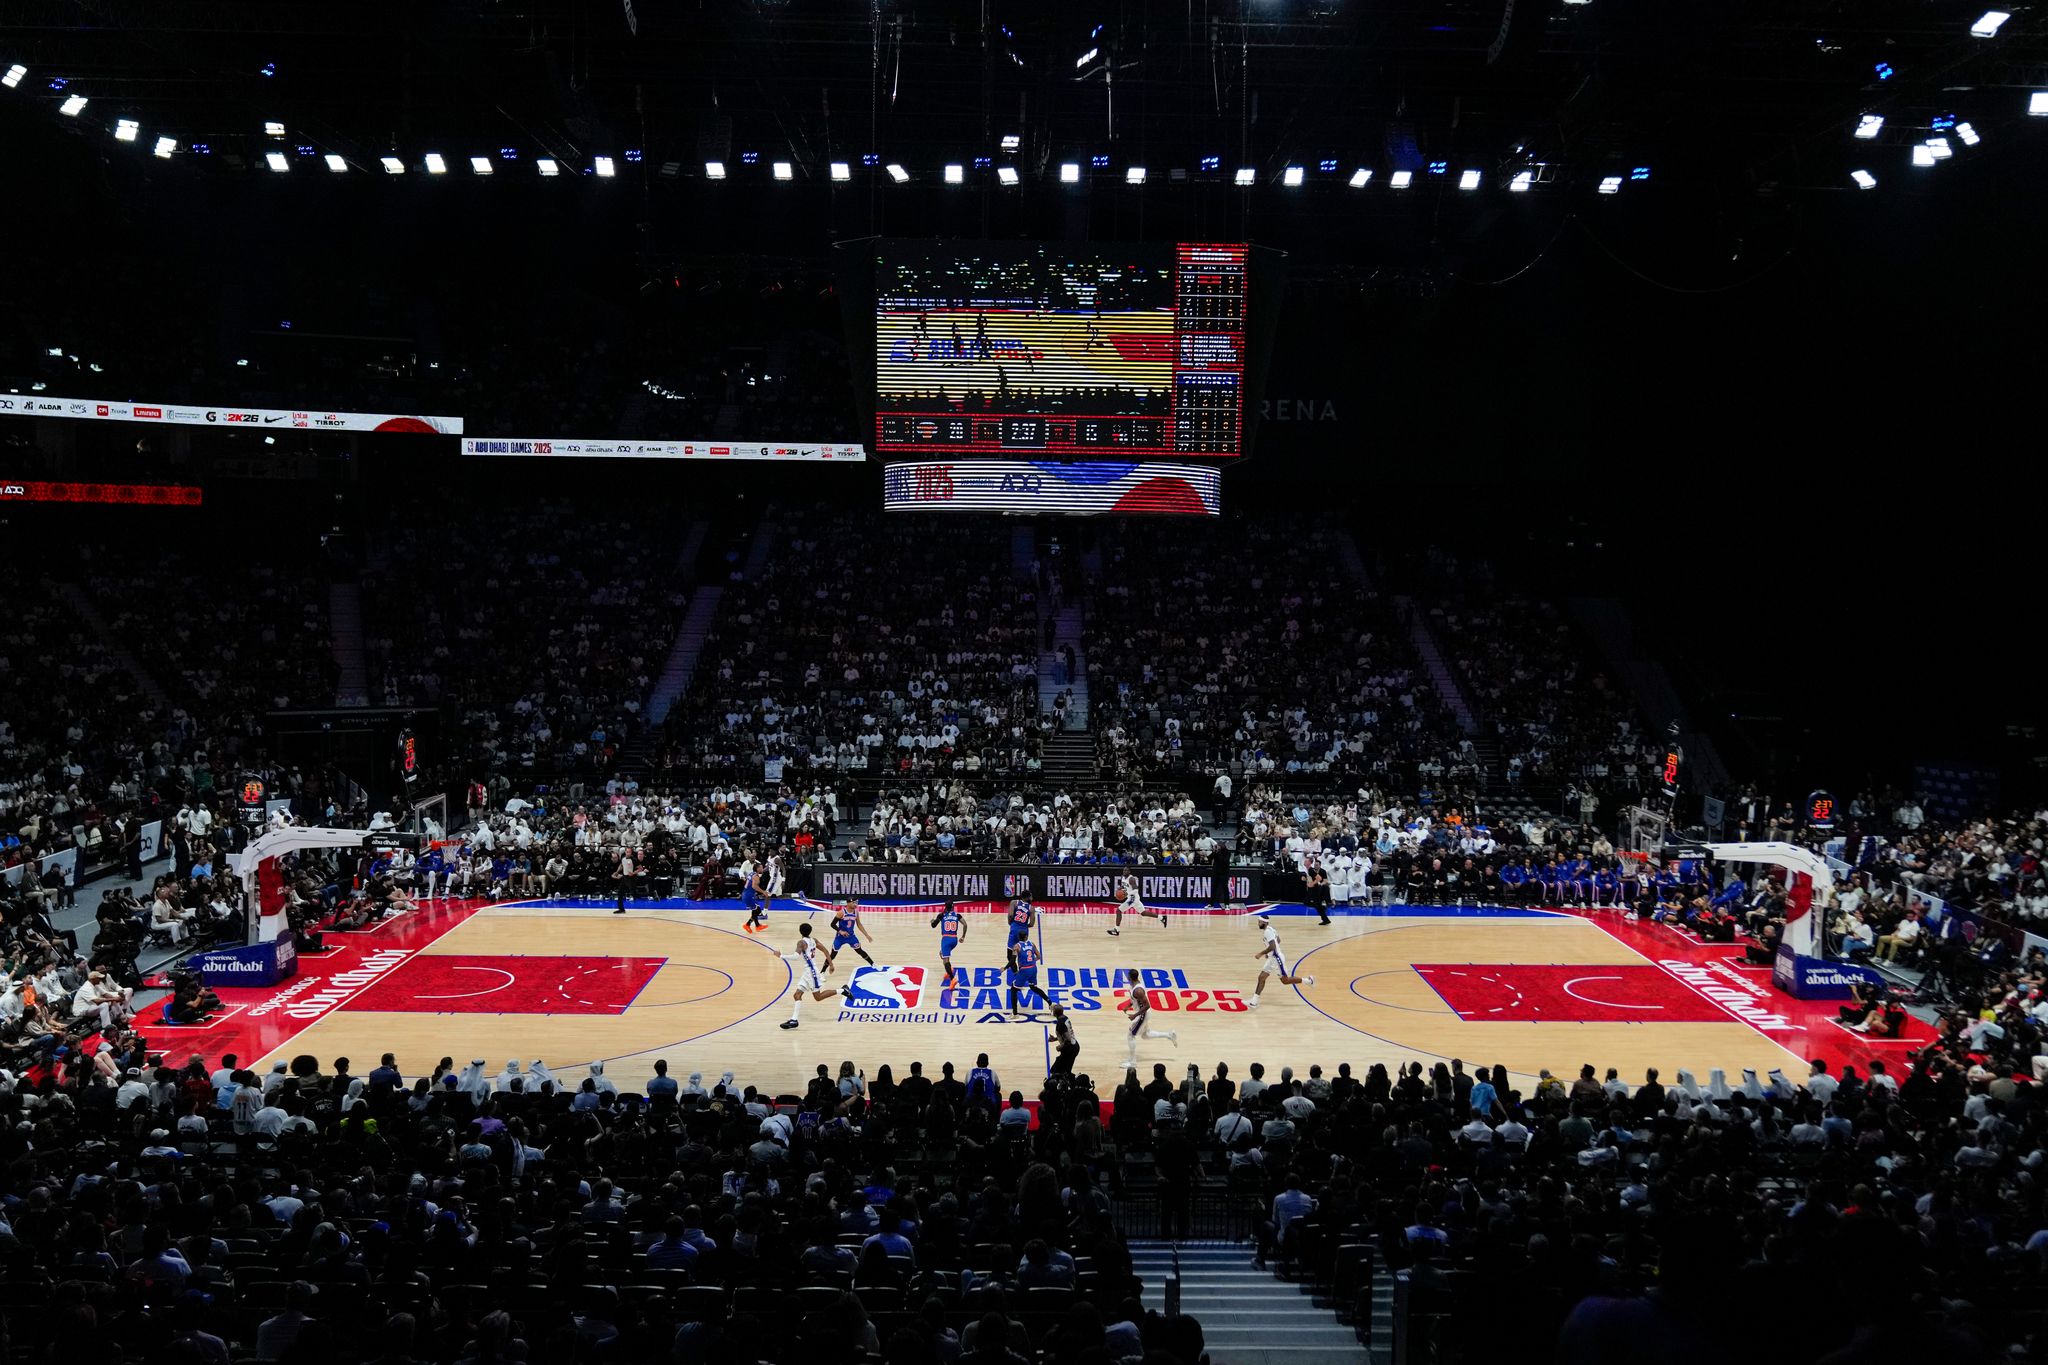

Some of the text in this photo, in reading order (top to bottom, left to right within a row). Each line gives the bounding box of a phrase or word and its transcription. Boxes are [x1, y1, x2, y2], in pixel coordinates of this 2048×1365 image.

[1260, 399, 1338, 421] RENA
[475, 442, 552, 454] ABU DHABI GAMES 2025
[1813, 807, 1830, 819] 22
[823, 873, 989, 897] REWARDS FOR EVERY FAN
[1047, 875, 1111, 897] REWARDS
[1142, 876, 1184, 898] EVERY
[1187, 877, 1212, 898] FAN
[1236, 877, 1250, 898] iD
[1014, 910, 1028, 924] 23
[202, 961, 264, 972] abu dhabi
[283, 988, 356, 1019] abu
[329, 948, 415, 987] dhabi
[1047, 968, 1190, 988] DHABI
[1704, 960, 1772, 997] experience
[1806, 974, 1829, 985] abu
[247, 976, 322, 1016] experience
[853, 998, 890, 1007] NBA
[939, 988, 1249, 1012] GAMES 2025
[1658, 959, 1808, 1031] abu dhabi
[837, 1010, 938, 1023] Presented
[943, 1012, 966, 1025] by
